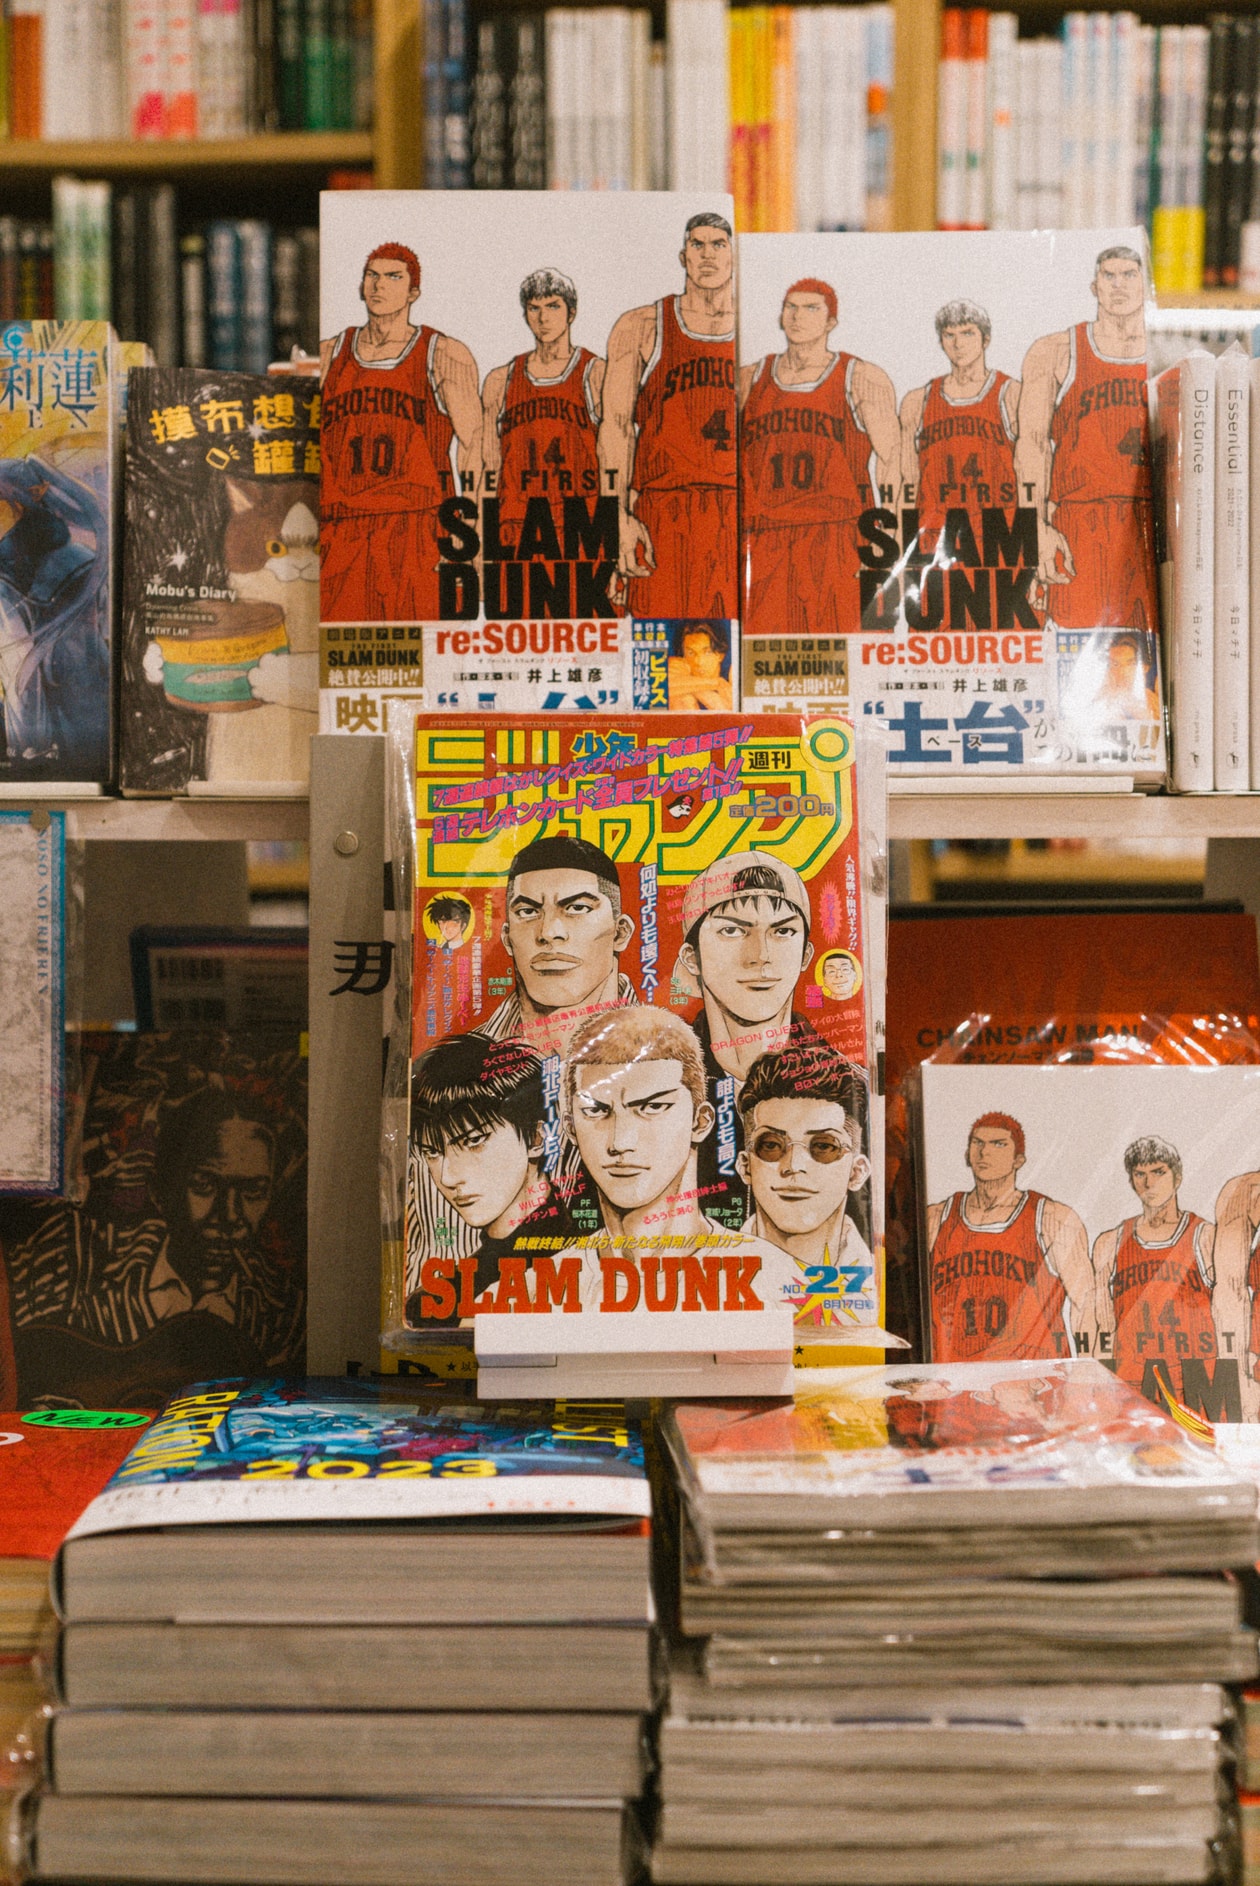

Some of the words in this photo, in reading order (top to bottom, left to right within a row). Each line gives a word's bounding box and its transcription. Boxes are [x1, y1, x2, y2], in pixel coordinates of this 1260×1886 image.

[702, 410, 731, 450] 4
[1193, 389, 1209, 474] Distance
[1227, 389, 1243, 475] Essential
[349, 434, 393, 476] 10
[528, 438, 568, 477] 14
[1118, 427, 1146, 465] 4
[439, 469, 497, 491] THE
[520, 469, 620, 491] FIRST
[770, 455, 815, 490] 10
[946, 456, 983, 490] 14
[858, 483, 917, 503] THE
[940, 483, 1037, 503] FIRST
[437, 496, 620, 563] SLAM
[857, 508, 1040, 569] SLAM
[146, 583, 195, 598] Mobu's
[199, 586, 237, 602] Diary
[438, 561, 621, 620] DUNK
[860, 569, 1044, 631] DUNK
[436, 622, 619, 654] re:SOURCE
[861, 635, 1044, 666] re:SOURCE
[327, 650, 375, 666] SLAM
[376, 650, 420, 666] DUNK
[754, 660, 799, 676] SLAM
[801, 660, 845, 676] DUNK
[527, 667, 603, 684] 井上雄彦
[952, 678, 1028, 693] 井上雄彦
[748, 750, 791, 770] 週刊
[729, 795, 834, 818] 定価200円
[710, 1032, 763, 1052] DRAGON
[765, 1021, 806, 1039] QUEST
[916, 1025, 1067, 1048] CHAINSAW
[1076, 1023, 1139, 1045] MAN
[518, 1196, 548, 1212] WILD
[804, 1265, 873, 1294] 27
[932, 1249, 1038, 1294] SHOHOKU
[420, 1256, 583, 1319] SLAM
[600, 1256, 764, 1314] DUNK
[960, 1296, 1009, 1337] 10
[1051, 1332, 1112, 1354] THE
[1136, 1332, 1237, 1354] FIRST
[31, 1411, 148, 1427] NEW
[240, 1459, 498, 1480] 2023
